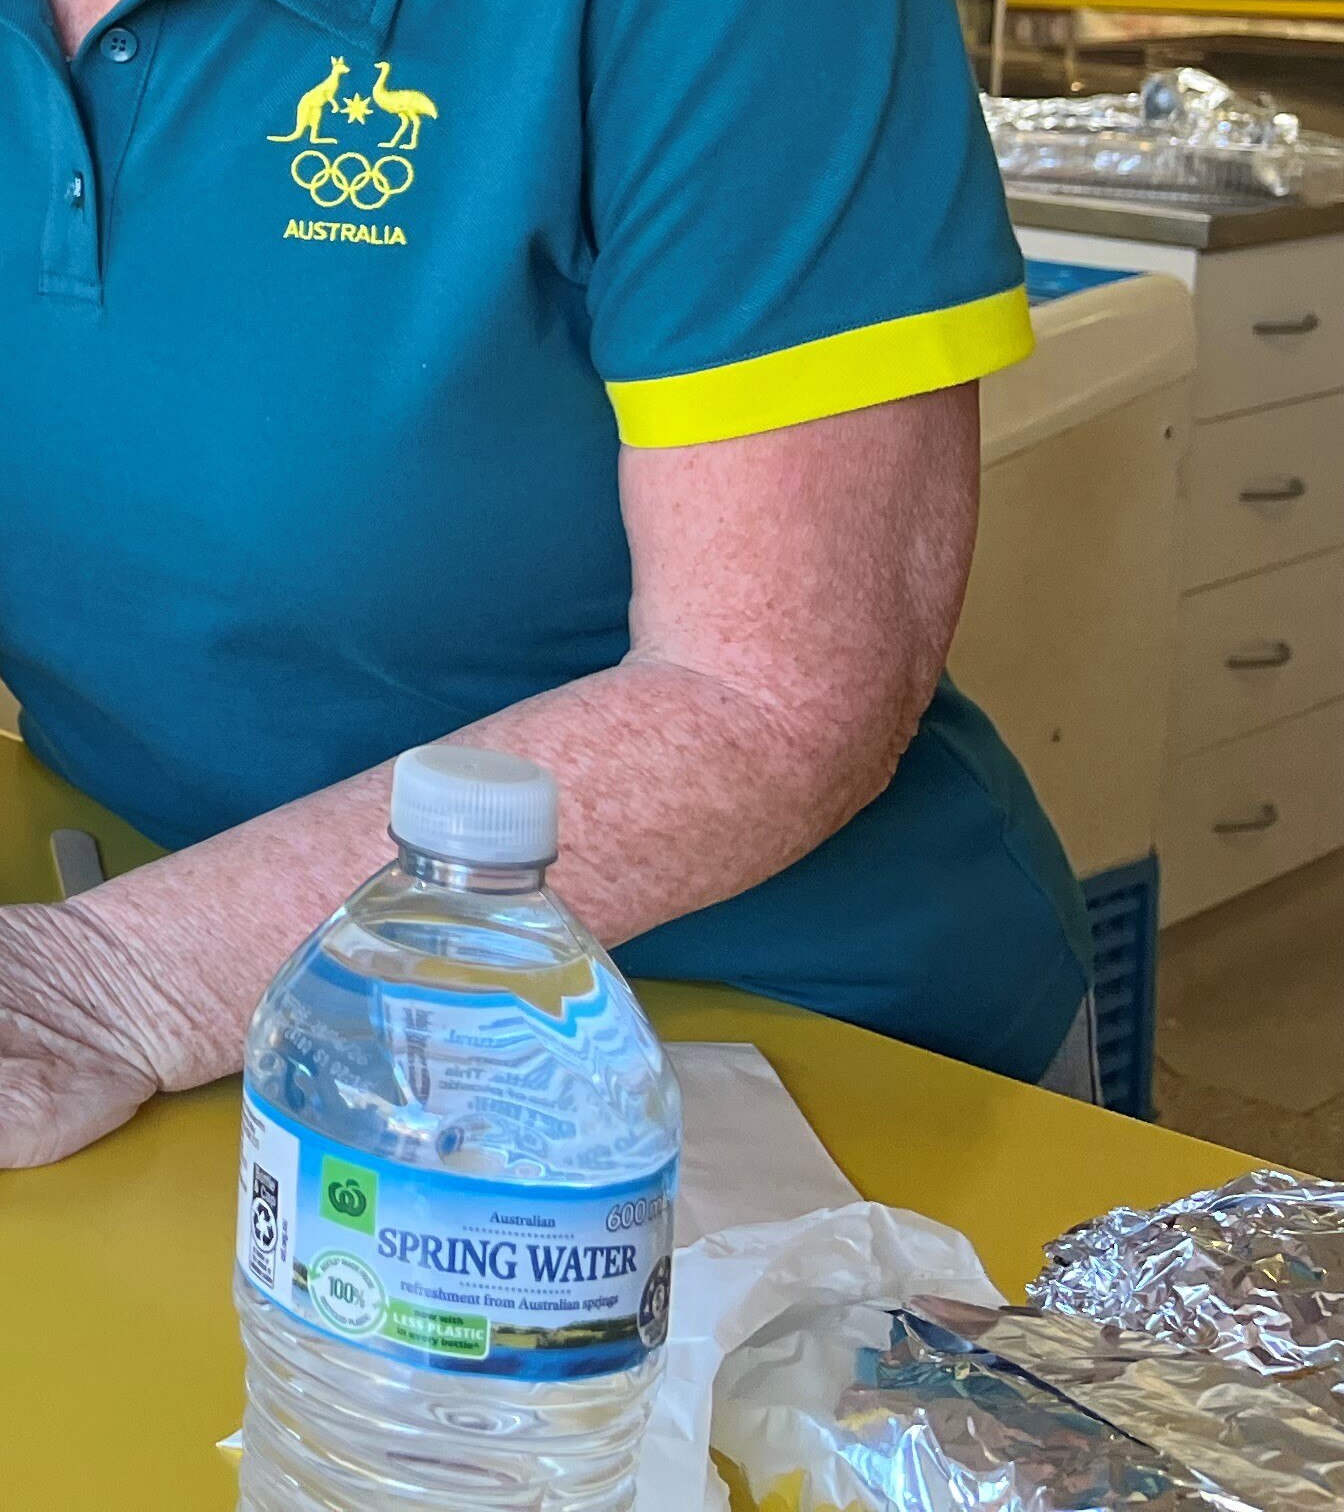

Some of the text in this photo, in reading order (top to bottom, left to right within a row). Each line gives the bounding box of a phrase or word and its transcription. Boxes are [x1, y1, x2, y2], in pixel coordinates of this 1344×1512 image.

[283, 219, 407, 245] AUSTRALIA
[489, 1211, 556, 1228] Australian
[377, 1227, 518, 1280] SPRING
[526, 1244, 637, 1283] WATER
[328, 1274, 366, 1309] 100%
[400, 1280, 480, 1306] refreshment
[483, 1292, 515, 1309] from
[518, 1297, 580, 1311] Australian
[427, 1319, 485, 1340] PLASTIC
